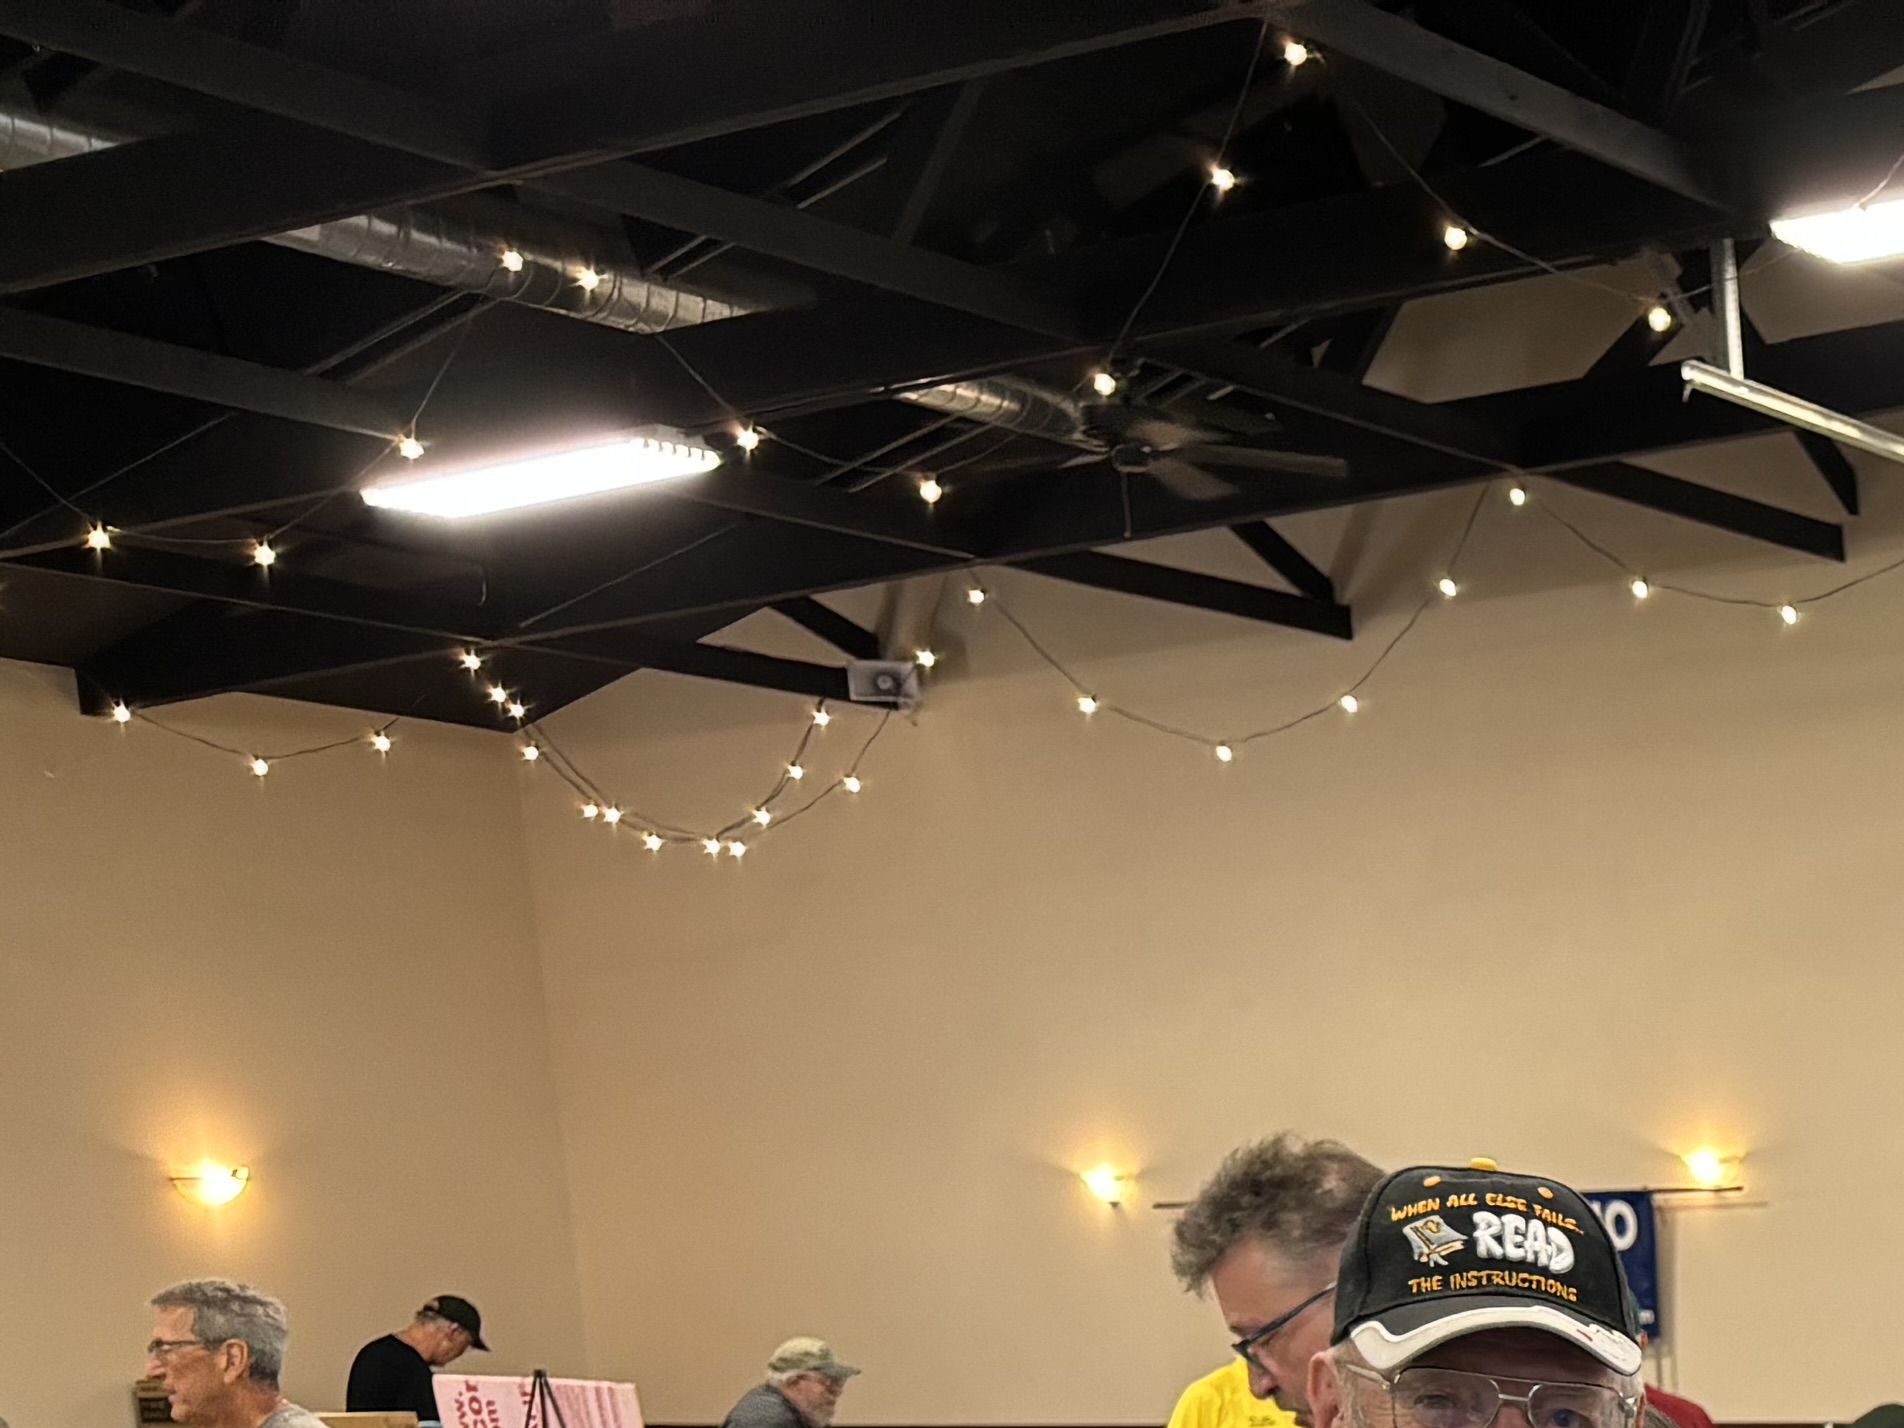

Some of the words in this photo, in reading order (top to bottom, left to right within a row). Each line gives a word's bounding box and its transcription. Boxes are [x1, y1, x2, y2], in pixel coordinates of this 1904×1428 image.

[1390, 1198, 1440, 1222] WHEN
[1446, 1193, 1478, 1208] ALL
[1485, 1192, 1528, 1212] ELSE
[1472, 1211, 1576, 1274] READ
[1408, 1275, 1443, 1294] THE
[1450, 1270, 1578, 1302] INSTRUCTIONS
